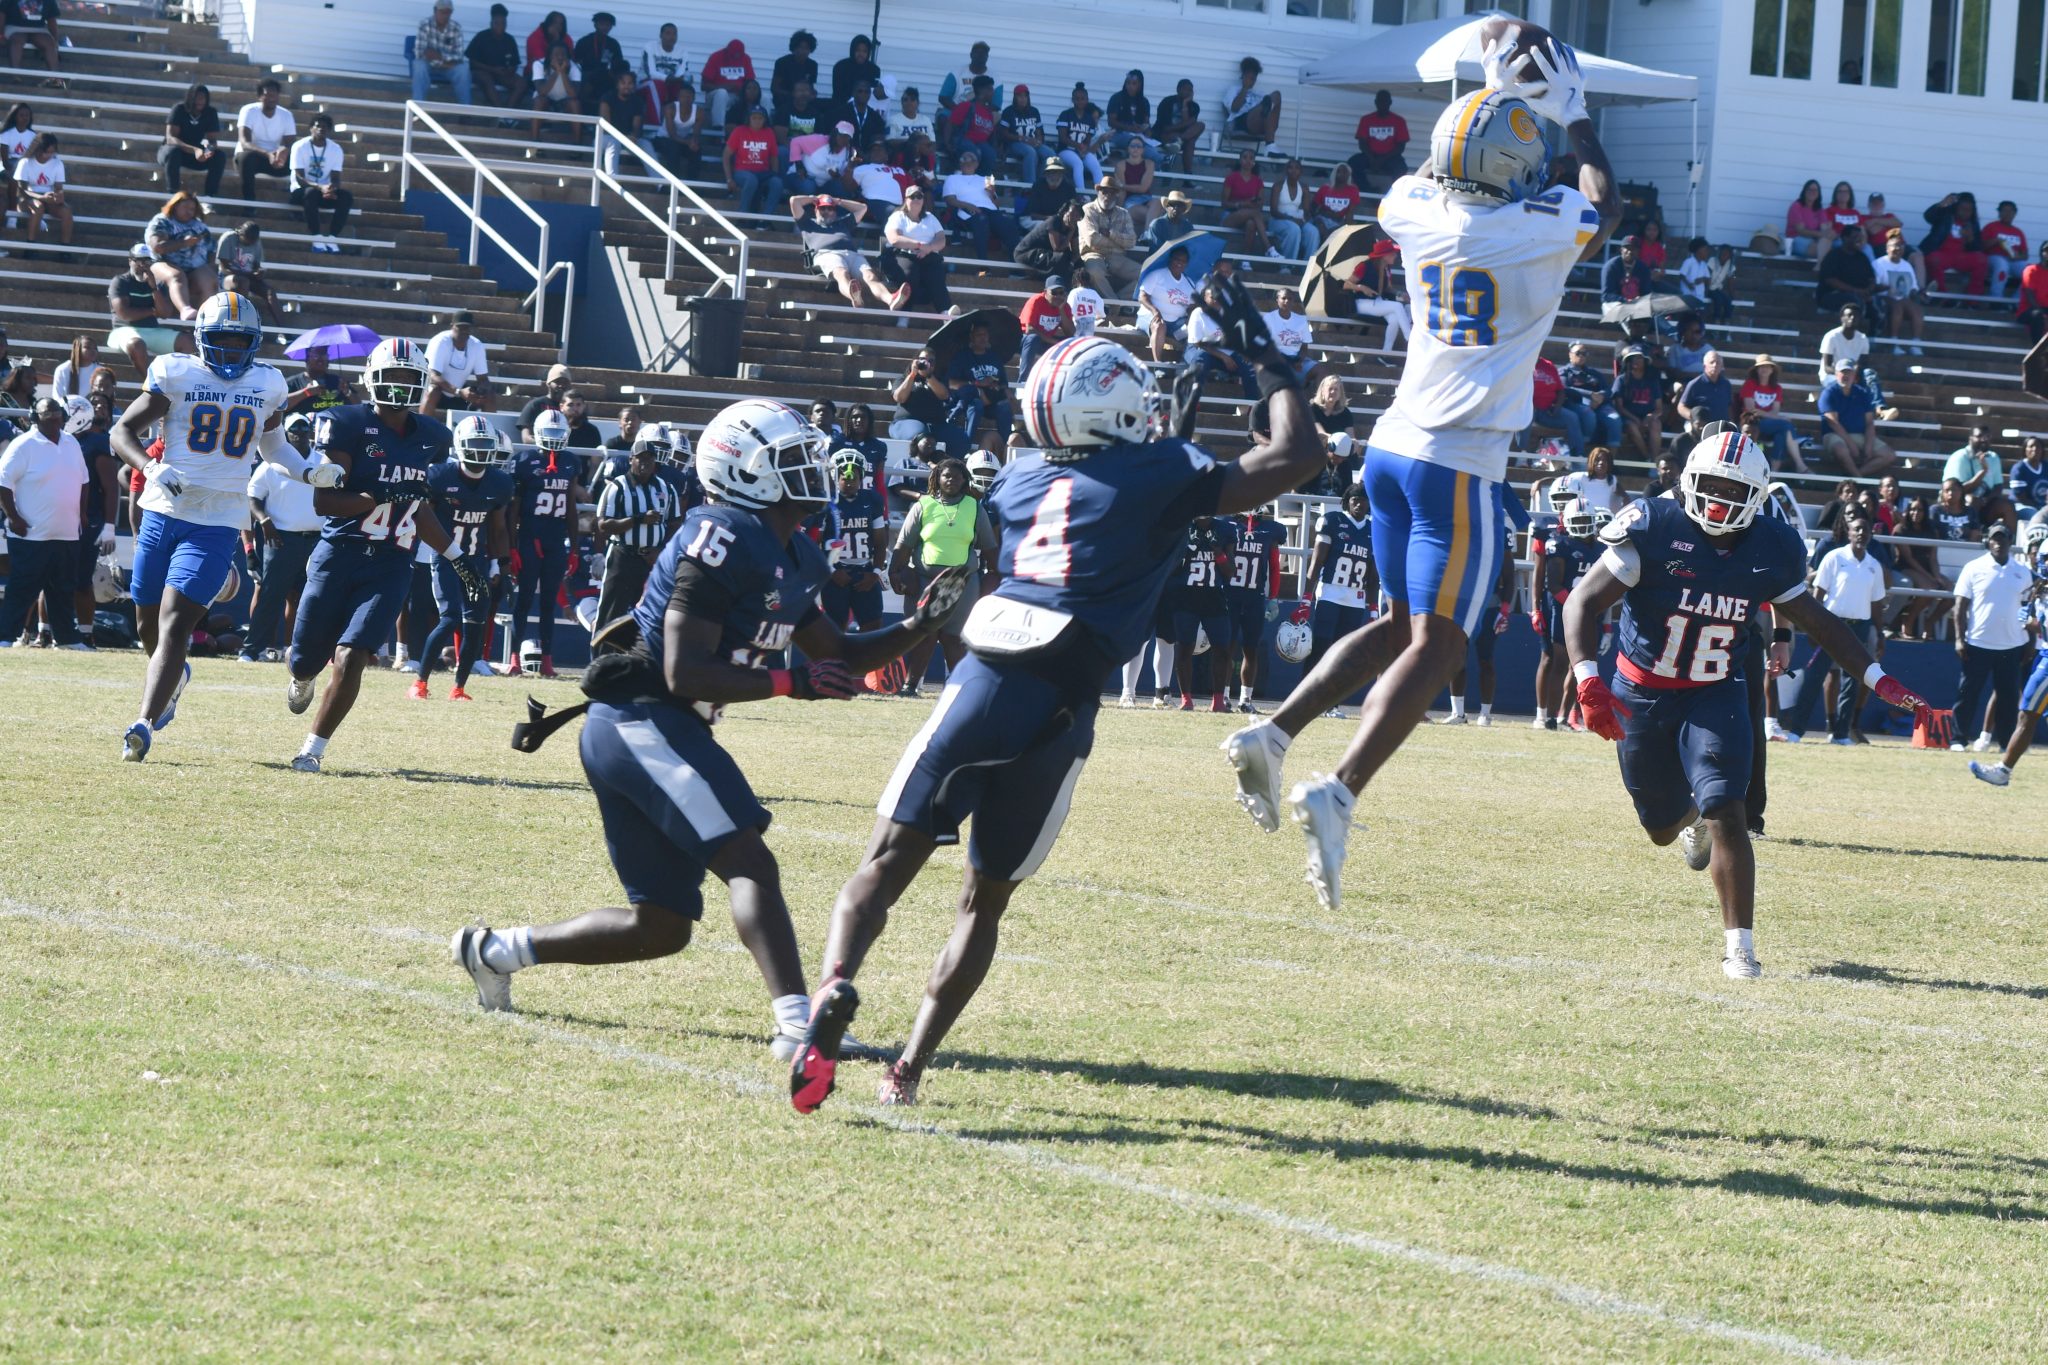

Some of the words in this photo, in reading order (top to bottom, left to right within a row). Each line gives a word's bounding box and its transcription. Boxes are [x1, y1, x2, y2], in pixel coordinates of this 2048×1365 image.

[1015, 117, 1037, 127] LANE
[743, 141, 767, 150] LANE
[1418, 260, 1499, 347] 18
[184, 391, 227, 402] ALBANY
[233, 394, 265, 409] STATE
[186, 402, 256, 460] 80
[378, 463, 426, 484] LANE
[544, 479, 569, 490] LANE
[360, 500, 421, 550] 44
[453, 510, 488, 524] LANE
[841, 518, 869, 529] LANE
[453, 525, 479, 556] 11
[686, 519, 737, 568] 15
[839, 532, 870, 559] 46
[1013, 477, 1074, 588] 4
[1236, 541, 1264, 554] LANE
[1343, 543, 1369, 558] LANE
[1187, 561, 1216, 588] 21
[1229, 555, 1260, 589] 31
[1331, 556, 1367, 590] 83
[1678, 588, 1750, 622] LANE
[1651, 615, 1736, 682] 16
